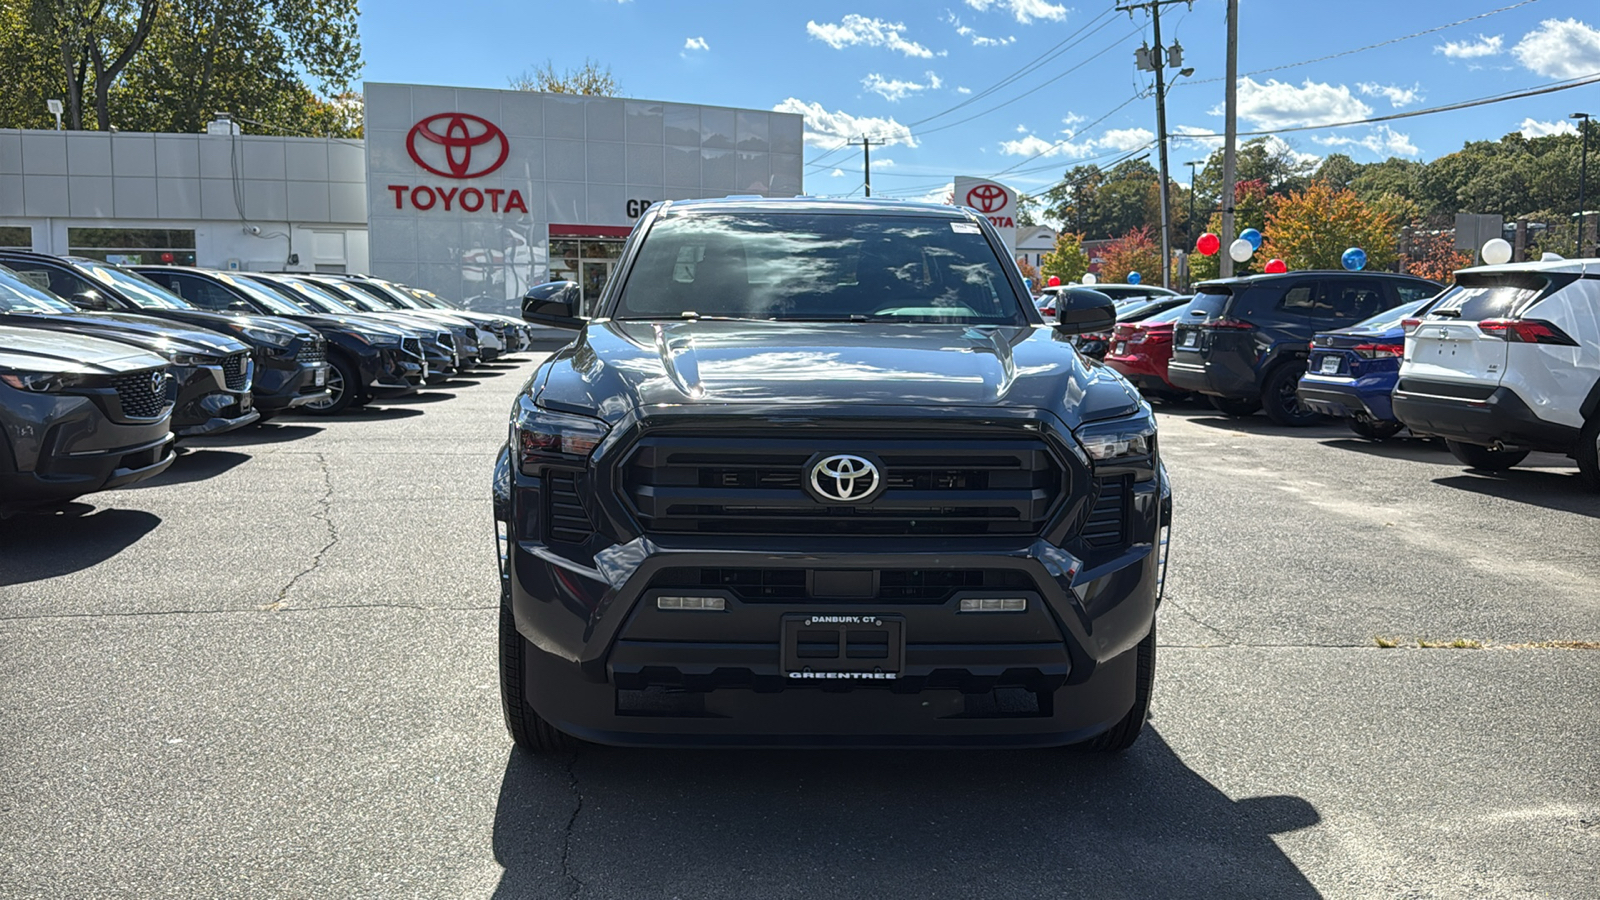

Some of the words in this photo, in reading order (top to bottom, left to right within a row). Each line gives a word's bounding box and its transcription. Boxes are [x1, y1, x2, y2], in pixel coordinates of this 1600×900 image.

[388, 185, 528, 213] TOYOTA
[988, 216, 1014, 228] OTA
[812, 616, 860, 624] DANBURY,
